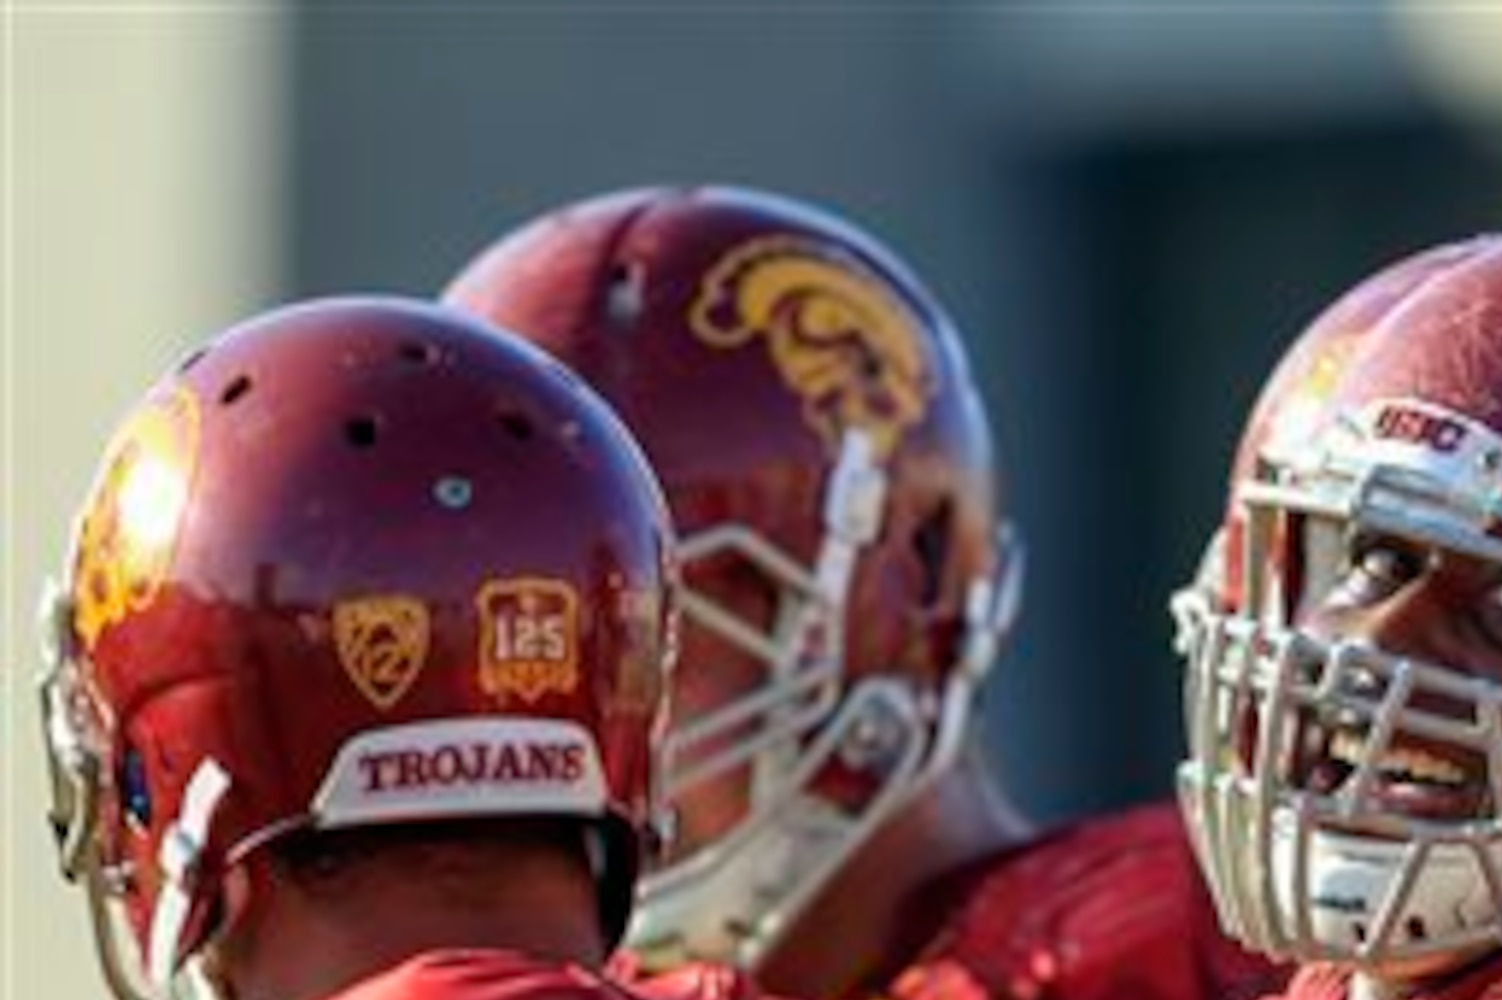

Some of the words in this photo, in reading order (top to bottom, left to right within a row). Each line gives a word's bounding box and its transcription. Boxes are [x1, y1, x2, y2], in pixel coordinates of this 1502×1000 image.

[1375, 405, 1468, 453] USC
[496, 611, 565, 661] 125
[357, 744, 586, 793] TROJANS
